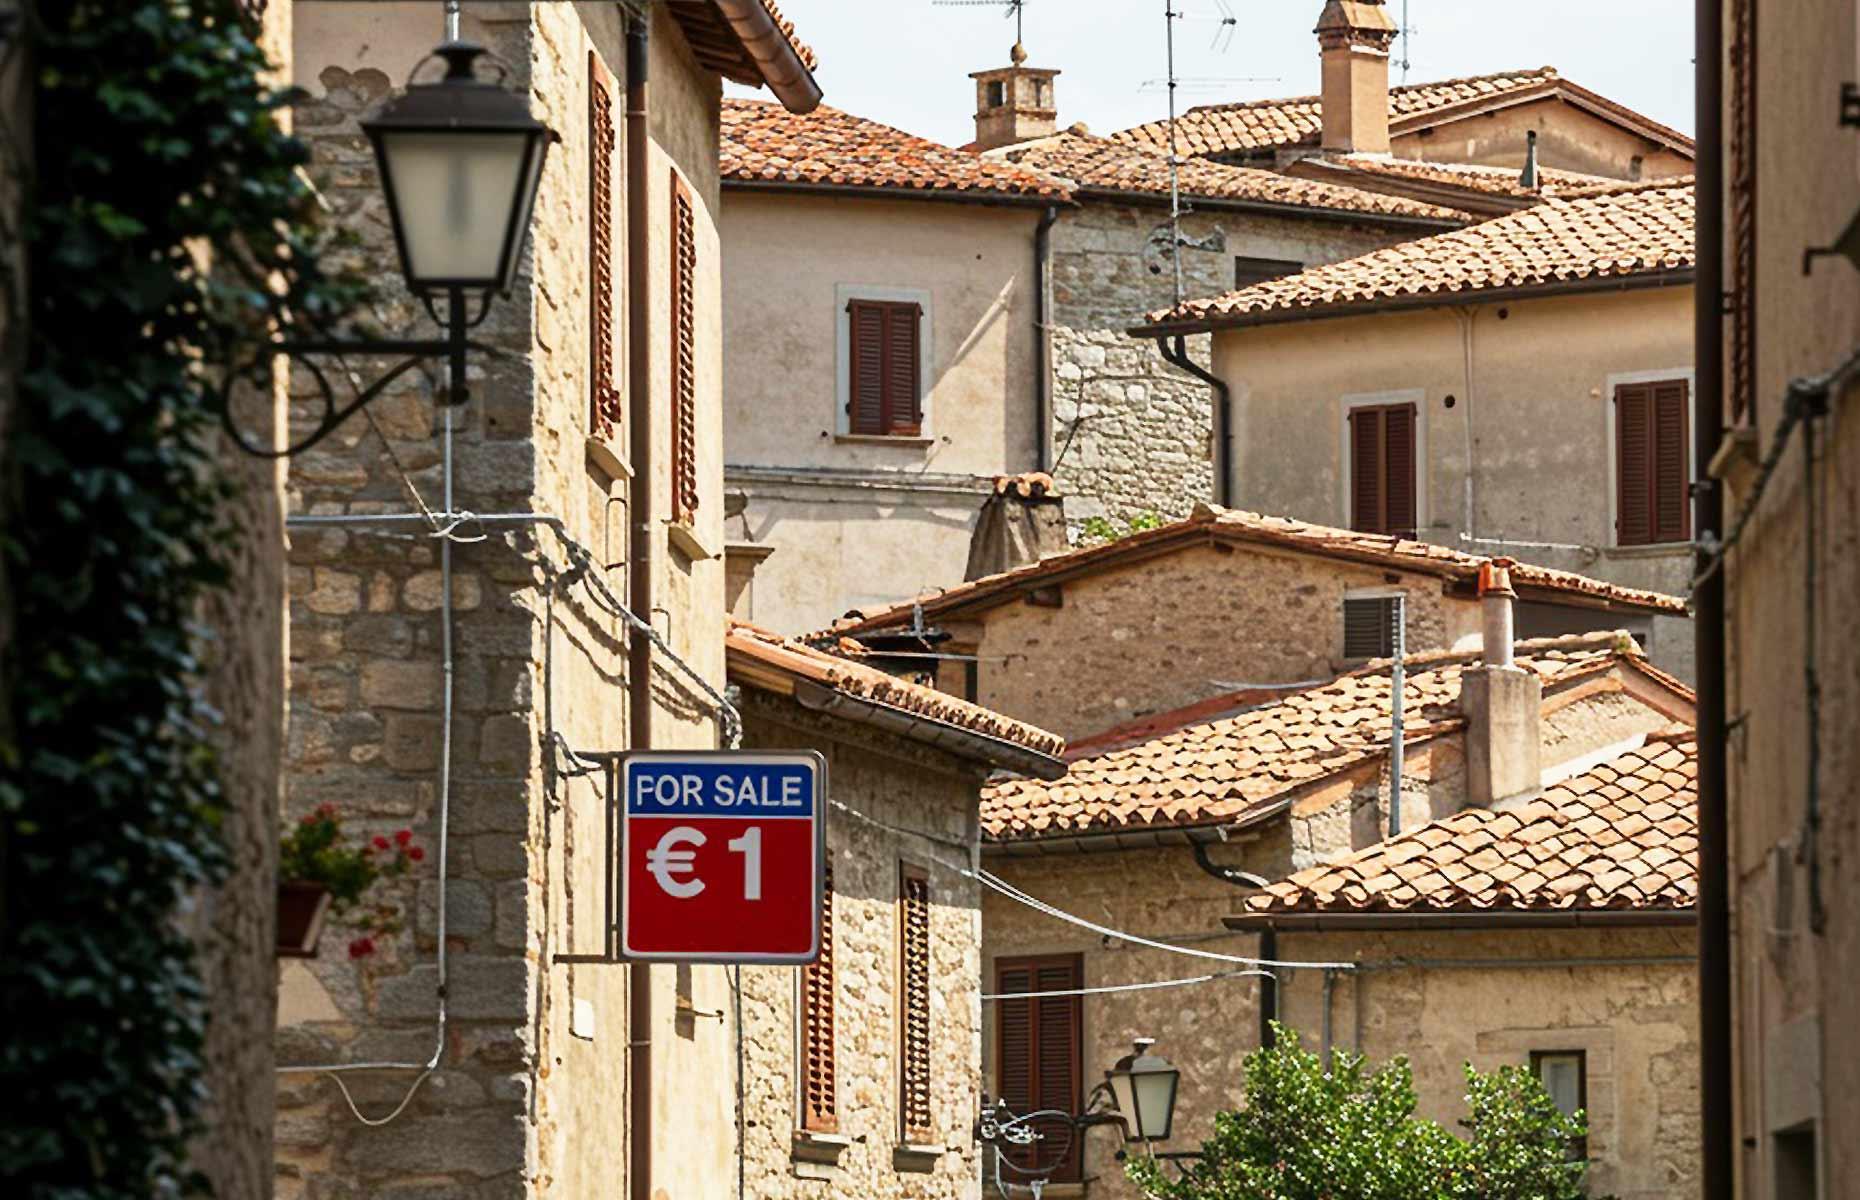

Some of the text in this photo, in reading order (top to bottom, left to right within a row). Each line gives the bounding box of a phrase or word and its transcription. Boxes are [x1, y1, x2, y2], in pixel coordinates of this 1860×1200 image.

[636, 775, 802, 806] FOR SALE
[646, 826, 761, 900] € 1
